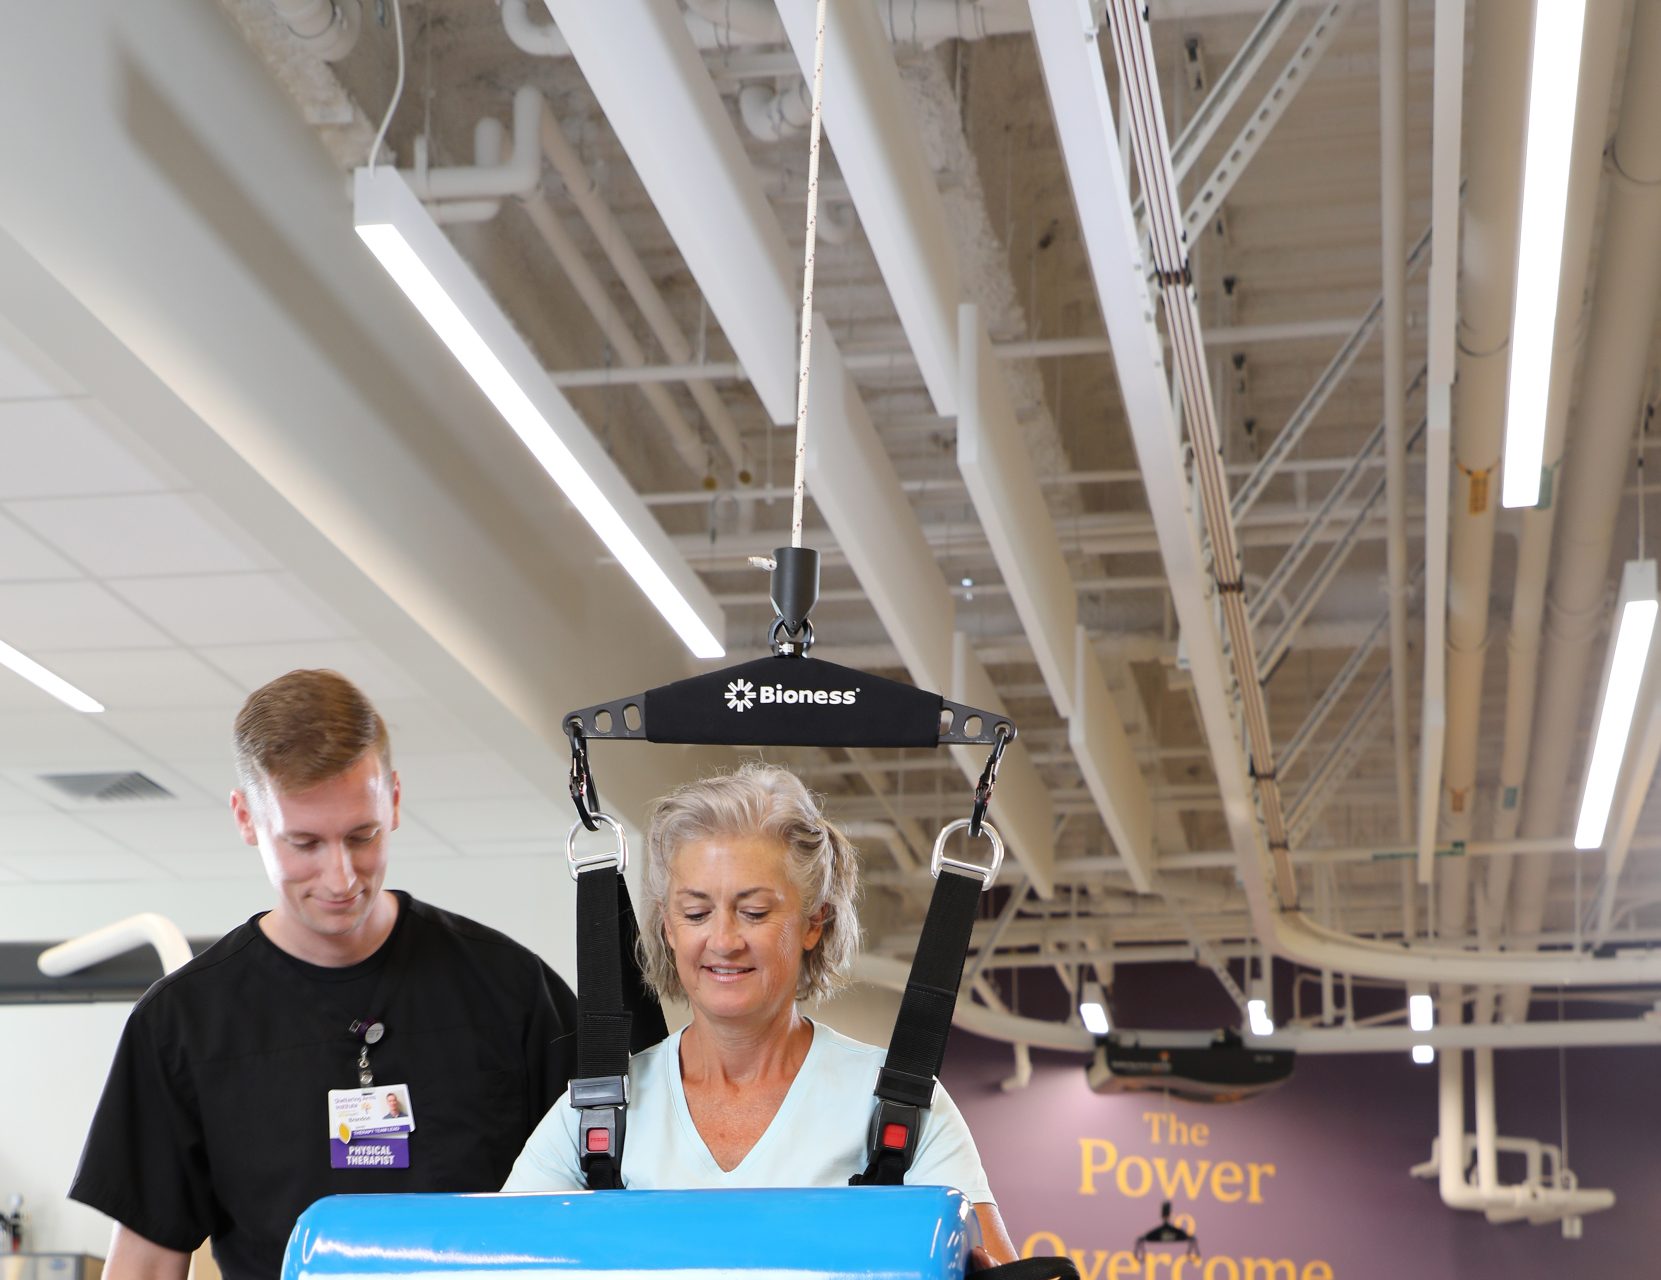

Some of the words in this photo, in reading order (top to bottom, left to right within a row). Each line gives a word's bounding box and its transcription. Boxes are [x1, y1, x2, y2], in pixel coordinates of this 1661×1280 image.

[760, 684, 857, 705] Bioness
[1143, 1111, 1210, 1147] The
[346, 1155, 395, 1166] THERAPIST
[348, 1145, 392, 1155] PHYSICAL
[1078, 1138, 1277, 1204] Power
